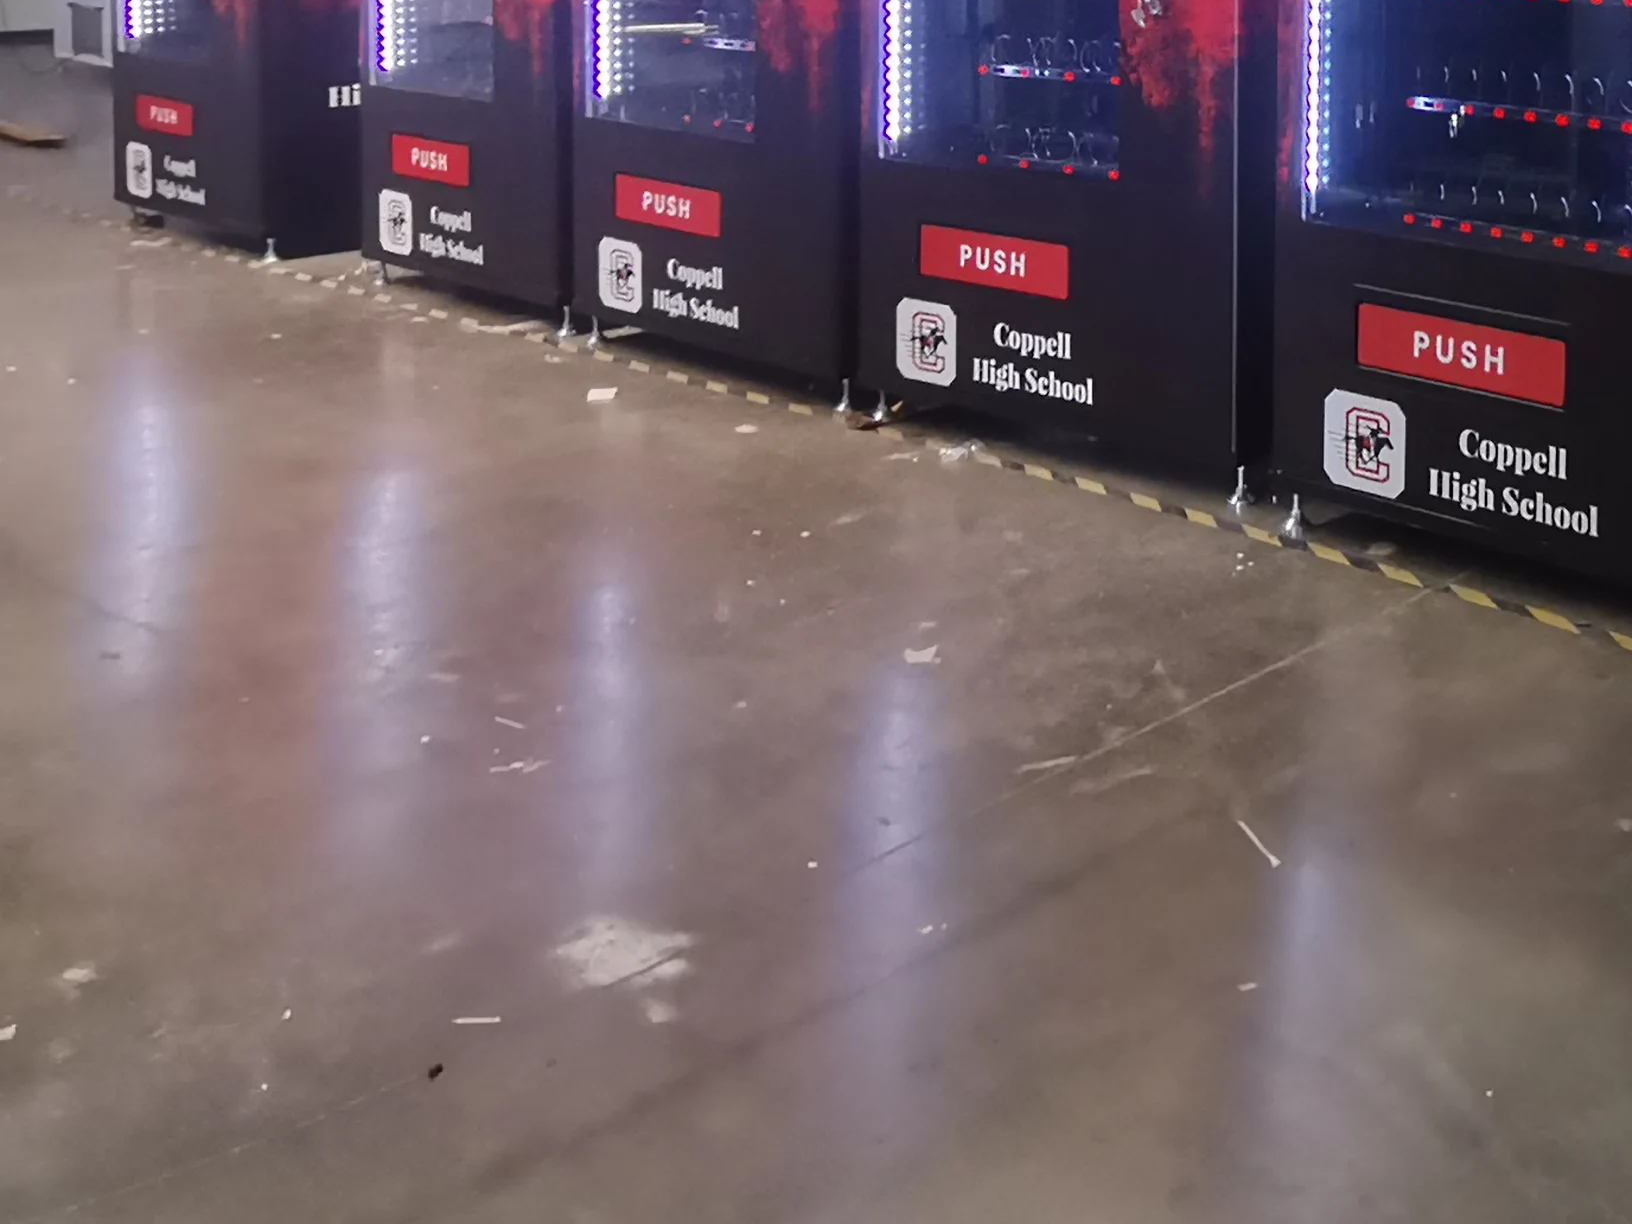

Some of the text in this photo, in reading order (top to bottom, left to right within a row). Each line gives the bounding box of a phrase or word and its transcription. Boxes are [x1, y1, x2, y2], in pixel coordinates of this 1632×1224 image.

[328, 83, 362, 108] Hi
[150, 105, 178, 124] PUSH
[411, 147, 448, 172] PUSH
[642, 191, 691, 219] PUSH
[419, 232, 484, 266] High School
[959, 244, 1027, 278] PUSH
[666, 258, 723, 291] Coppell
[652, 288, 740, 331] High School
[992, 321, 1072, 360] Coppell
[1412, 330, 1505, 376] PUSH
[972, 357, 1094, 406] High School
[1458, 428, 1568, 480] Coppell
[1428, 467, 1600, 539] High School
